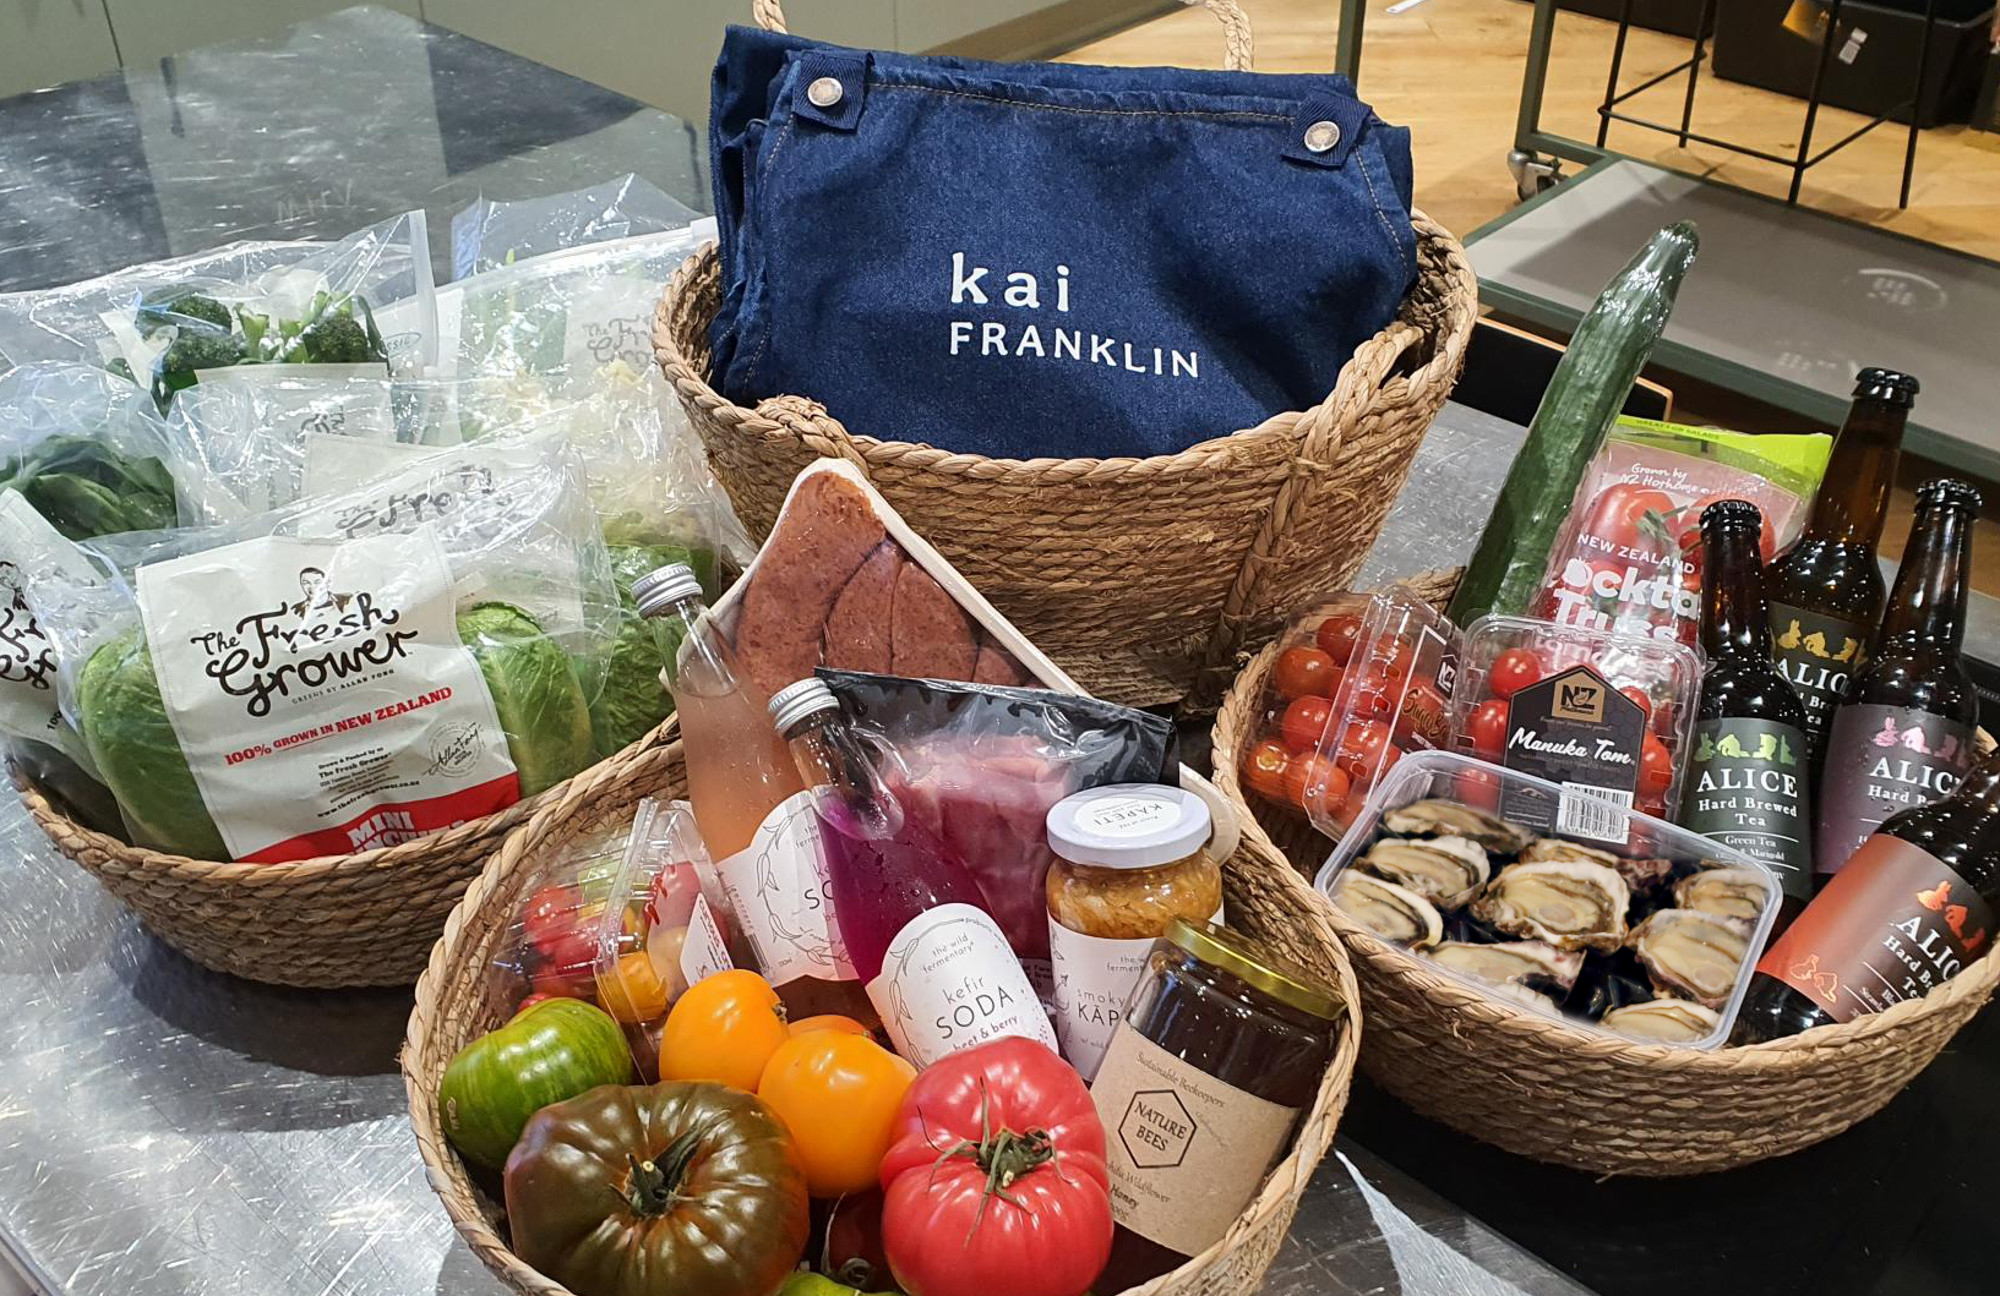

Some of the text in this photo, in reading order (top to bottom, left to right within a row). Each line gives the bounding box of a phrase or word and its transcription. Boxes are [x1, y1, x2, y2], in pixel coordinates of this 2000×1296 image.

[951, 252, 1070, 312] kai
[950, 322, 1198, 378] FRANKLIN
[1672, 464, 1688, 481] by
[1577, 533, 1696, 574] NEW ZEALAND
[1547, 556, 1700, 620] ockta
[190, 592, 400, 669] The Fresh
[205, 630, 419, 718] Grower
[1777, 657, 1850, 697] ALIC
[1560, 684, 1598, 710] NZ
[224, 686, 453, 765] 100% GROWN IN NEW ZEALAND
[1508, 726, 1588, 758] Manuka
[318, 769, 334, 780] The
[335, 761, 357, 775] Fresh
[1696, 768, 1798, 798] ALICE
[1869, 756, 1961, 795] ALIC
[1699, 797, 1798, 817] Hard Brewed
[1867, 784, 1910, 803] Hard
[346, 810, 415, 848] MINI
[804, 824, 818, 834] the
[1735, 813, 1767, 826] Tea
[795, 835, 820, 849] ferme
[1725, 835, 1777, 848] Green Tea
[932, 932, 969, 959] the wild
[1883, 935, 1922, 972] Hard
[1890, 915, 1961, 981] ALIC
[1107, 963, 1144, 973] ferment
[942, 976, 985, 1005] kefir
[1077, 988, 1126, 1007] smoky
[1901, 975, 1921, 999] Te
[936, 986, 1014, 1039] SODA
[979, 1026, 990, 1039] &
[991, 1014, 1019, 1033] berry
[1077, 1001, 1121, 1028] KĀP
[1136, 1050, 1226, 1108] Sustainable Beekeepers
[1133, 1100, 1188, 1140] NATURE
[1136, 1124, 1169, 1152] BEES
[1110, 1183, 1140, 1210] Honey
[1124, 1171, 1172, 1204] Wildflower
